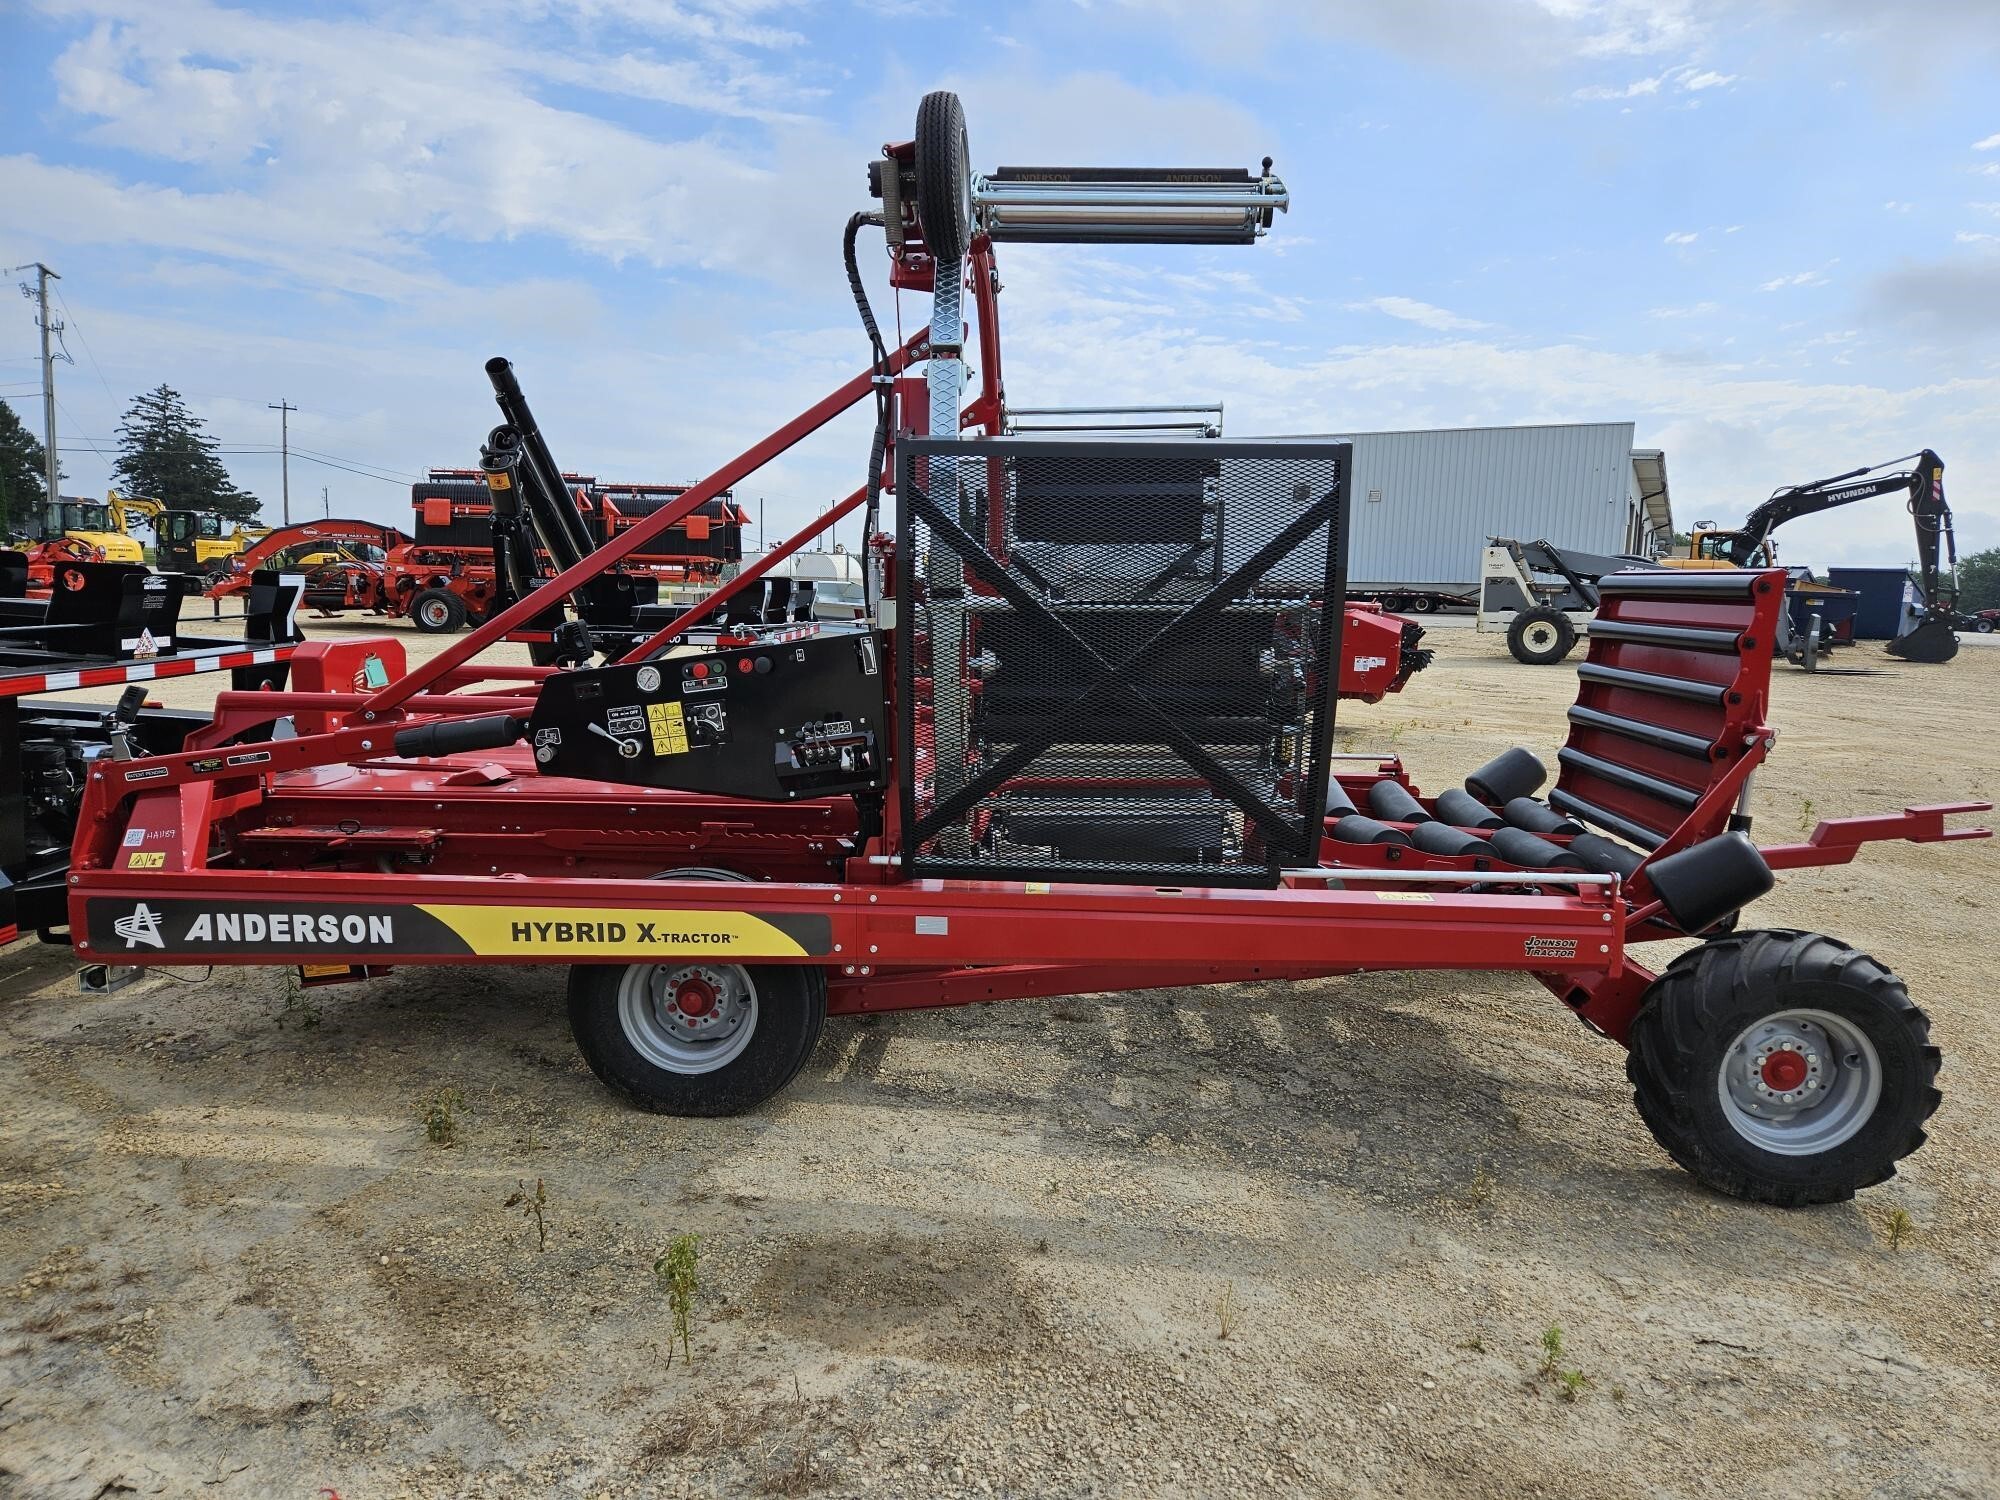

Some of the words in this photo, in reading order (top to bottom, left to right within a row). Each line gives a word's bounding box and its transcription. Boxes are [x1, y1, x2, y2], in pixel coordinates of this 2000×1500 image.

[1015, 174, 1071, 182] ANDERSON
[1166, 174, 1222, 182] ANDERSON
[1827, 485, 1877, 502] HYUNDAI
[145, 768, 167, 777] PENDING
[183, 912, 394, 944] ANDERSON
[511, 921, 626, 943] HYBRID
[1524, 936, 1578, 948] JOHNSON
[1525, 946, 1576, 958] TRACTOR
